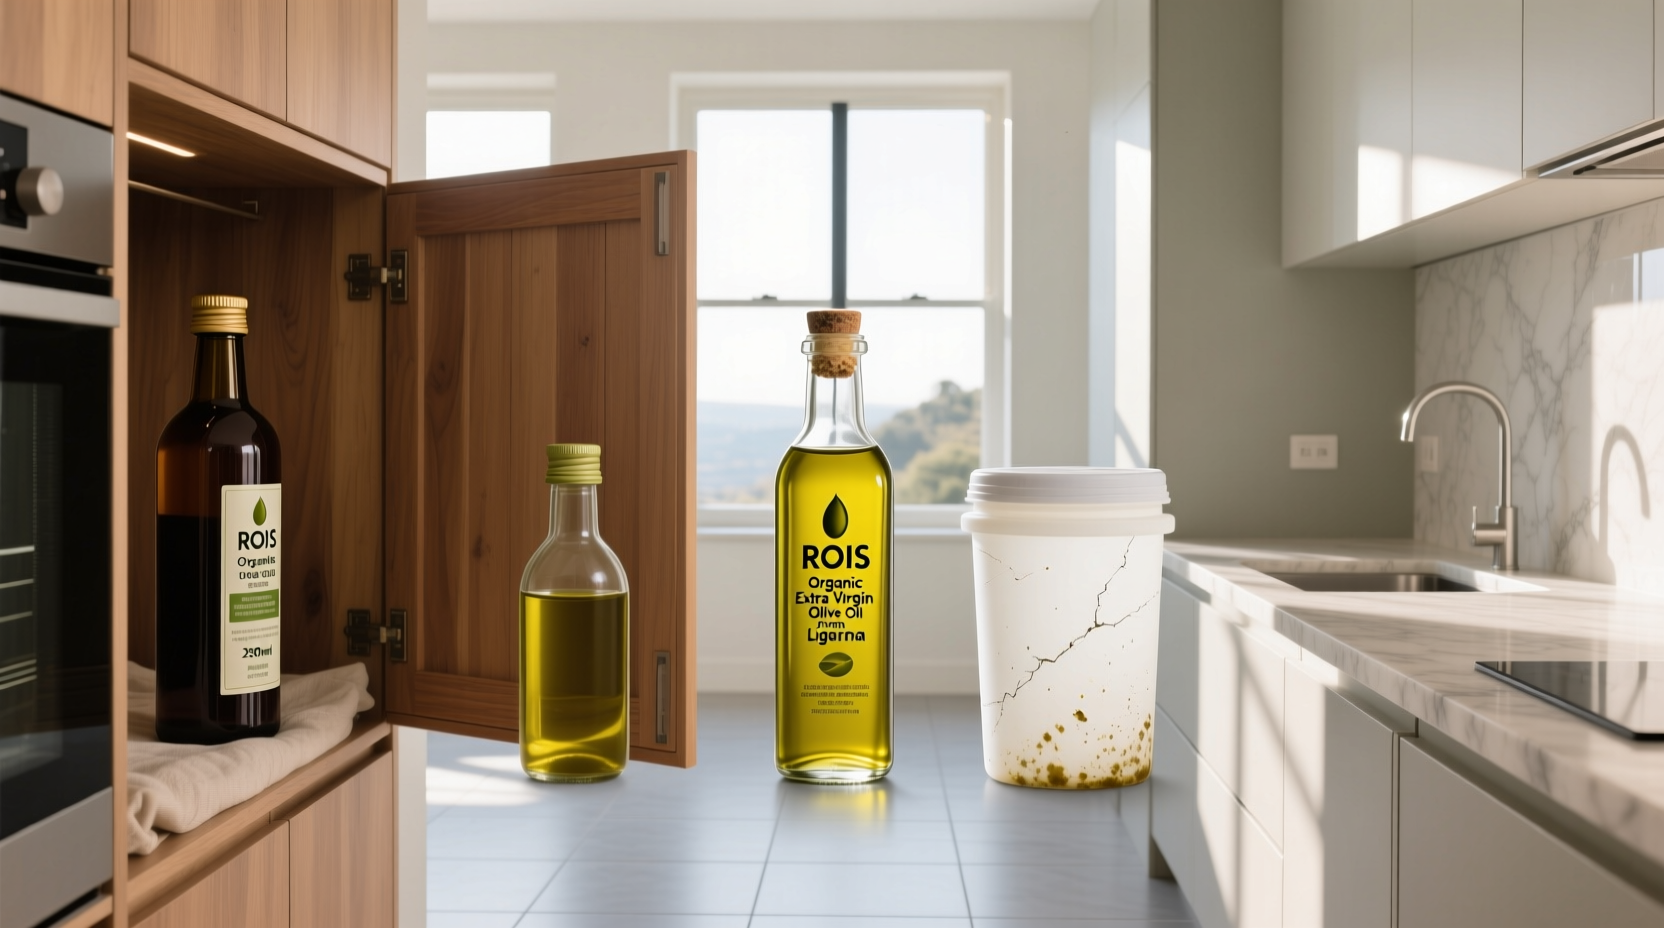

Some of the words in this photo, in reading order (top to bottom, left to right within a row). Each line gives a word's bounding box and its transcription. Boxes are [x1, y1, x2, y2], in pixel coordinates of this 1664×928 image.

[238, 529, 277, 551] ROIS
[802, 544, 870, 570] ROIS
[808, 576, 863, 592] Organic
[795, 591, 829, 605] Extra
